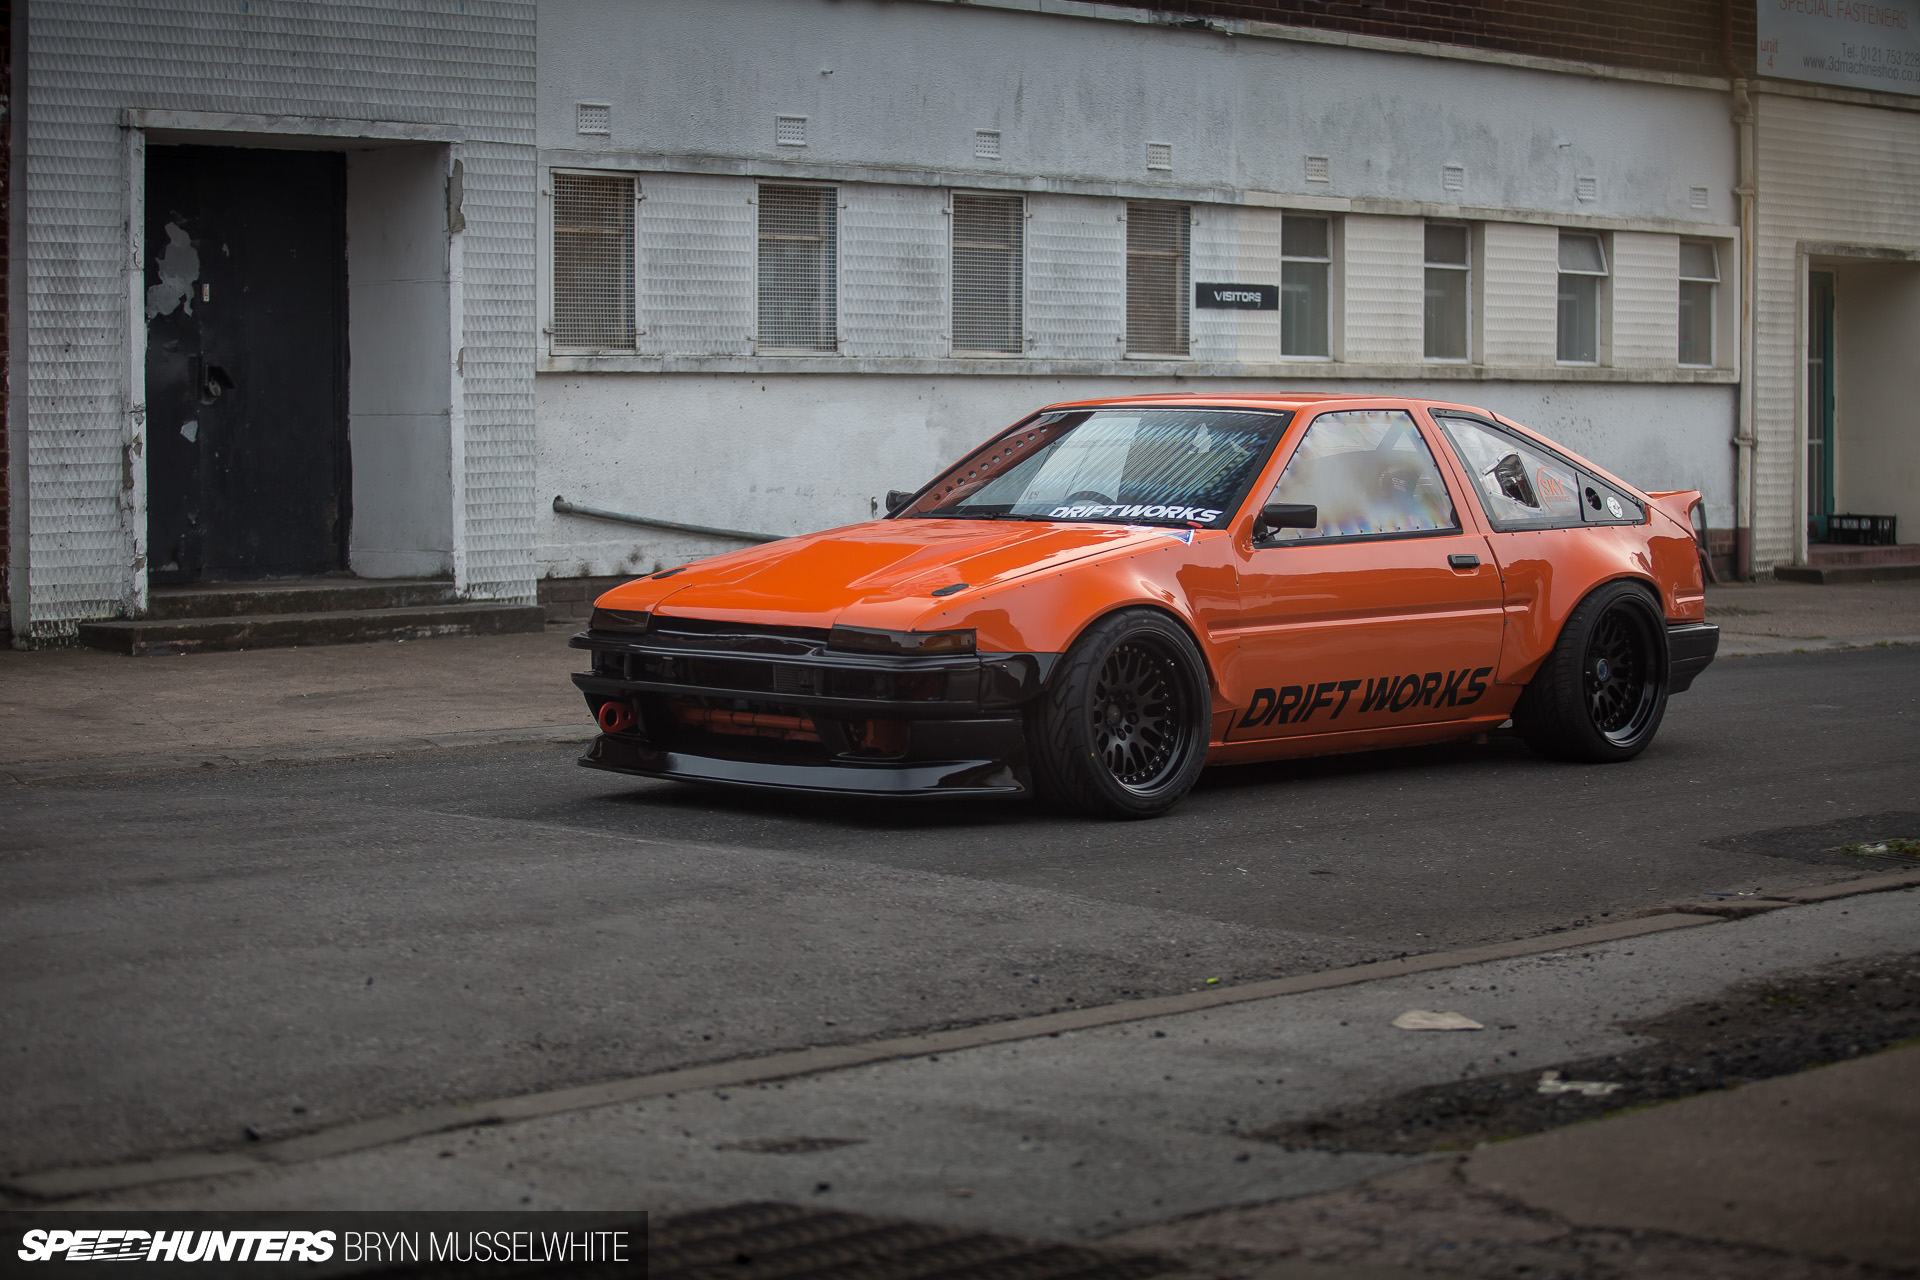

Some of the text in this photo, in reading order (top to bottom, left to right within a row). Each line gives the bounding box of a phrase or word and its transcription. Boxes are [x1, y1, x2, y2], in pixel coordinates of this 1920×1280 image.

[1779, 0, 1908, 30] SPECIAL FASTENERS
[1760, 38, 1778, 54] unit
[1841, 42, 1858, 59] Tel:
[1861, 45, 1881, 62] 0121
[1886, 48, 1902, 65] 753
[1767, 55, 1774, 69] 4
[1213, 291, 1262, 302] VISITORS
[1540, 478, 1565, 495] SKY
[1048, 505, 1223, 522] DRIFTWORKS
[1236, 666, 1494, 728] DRIFT WORKS
